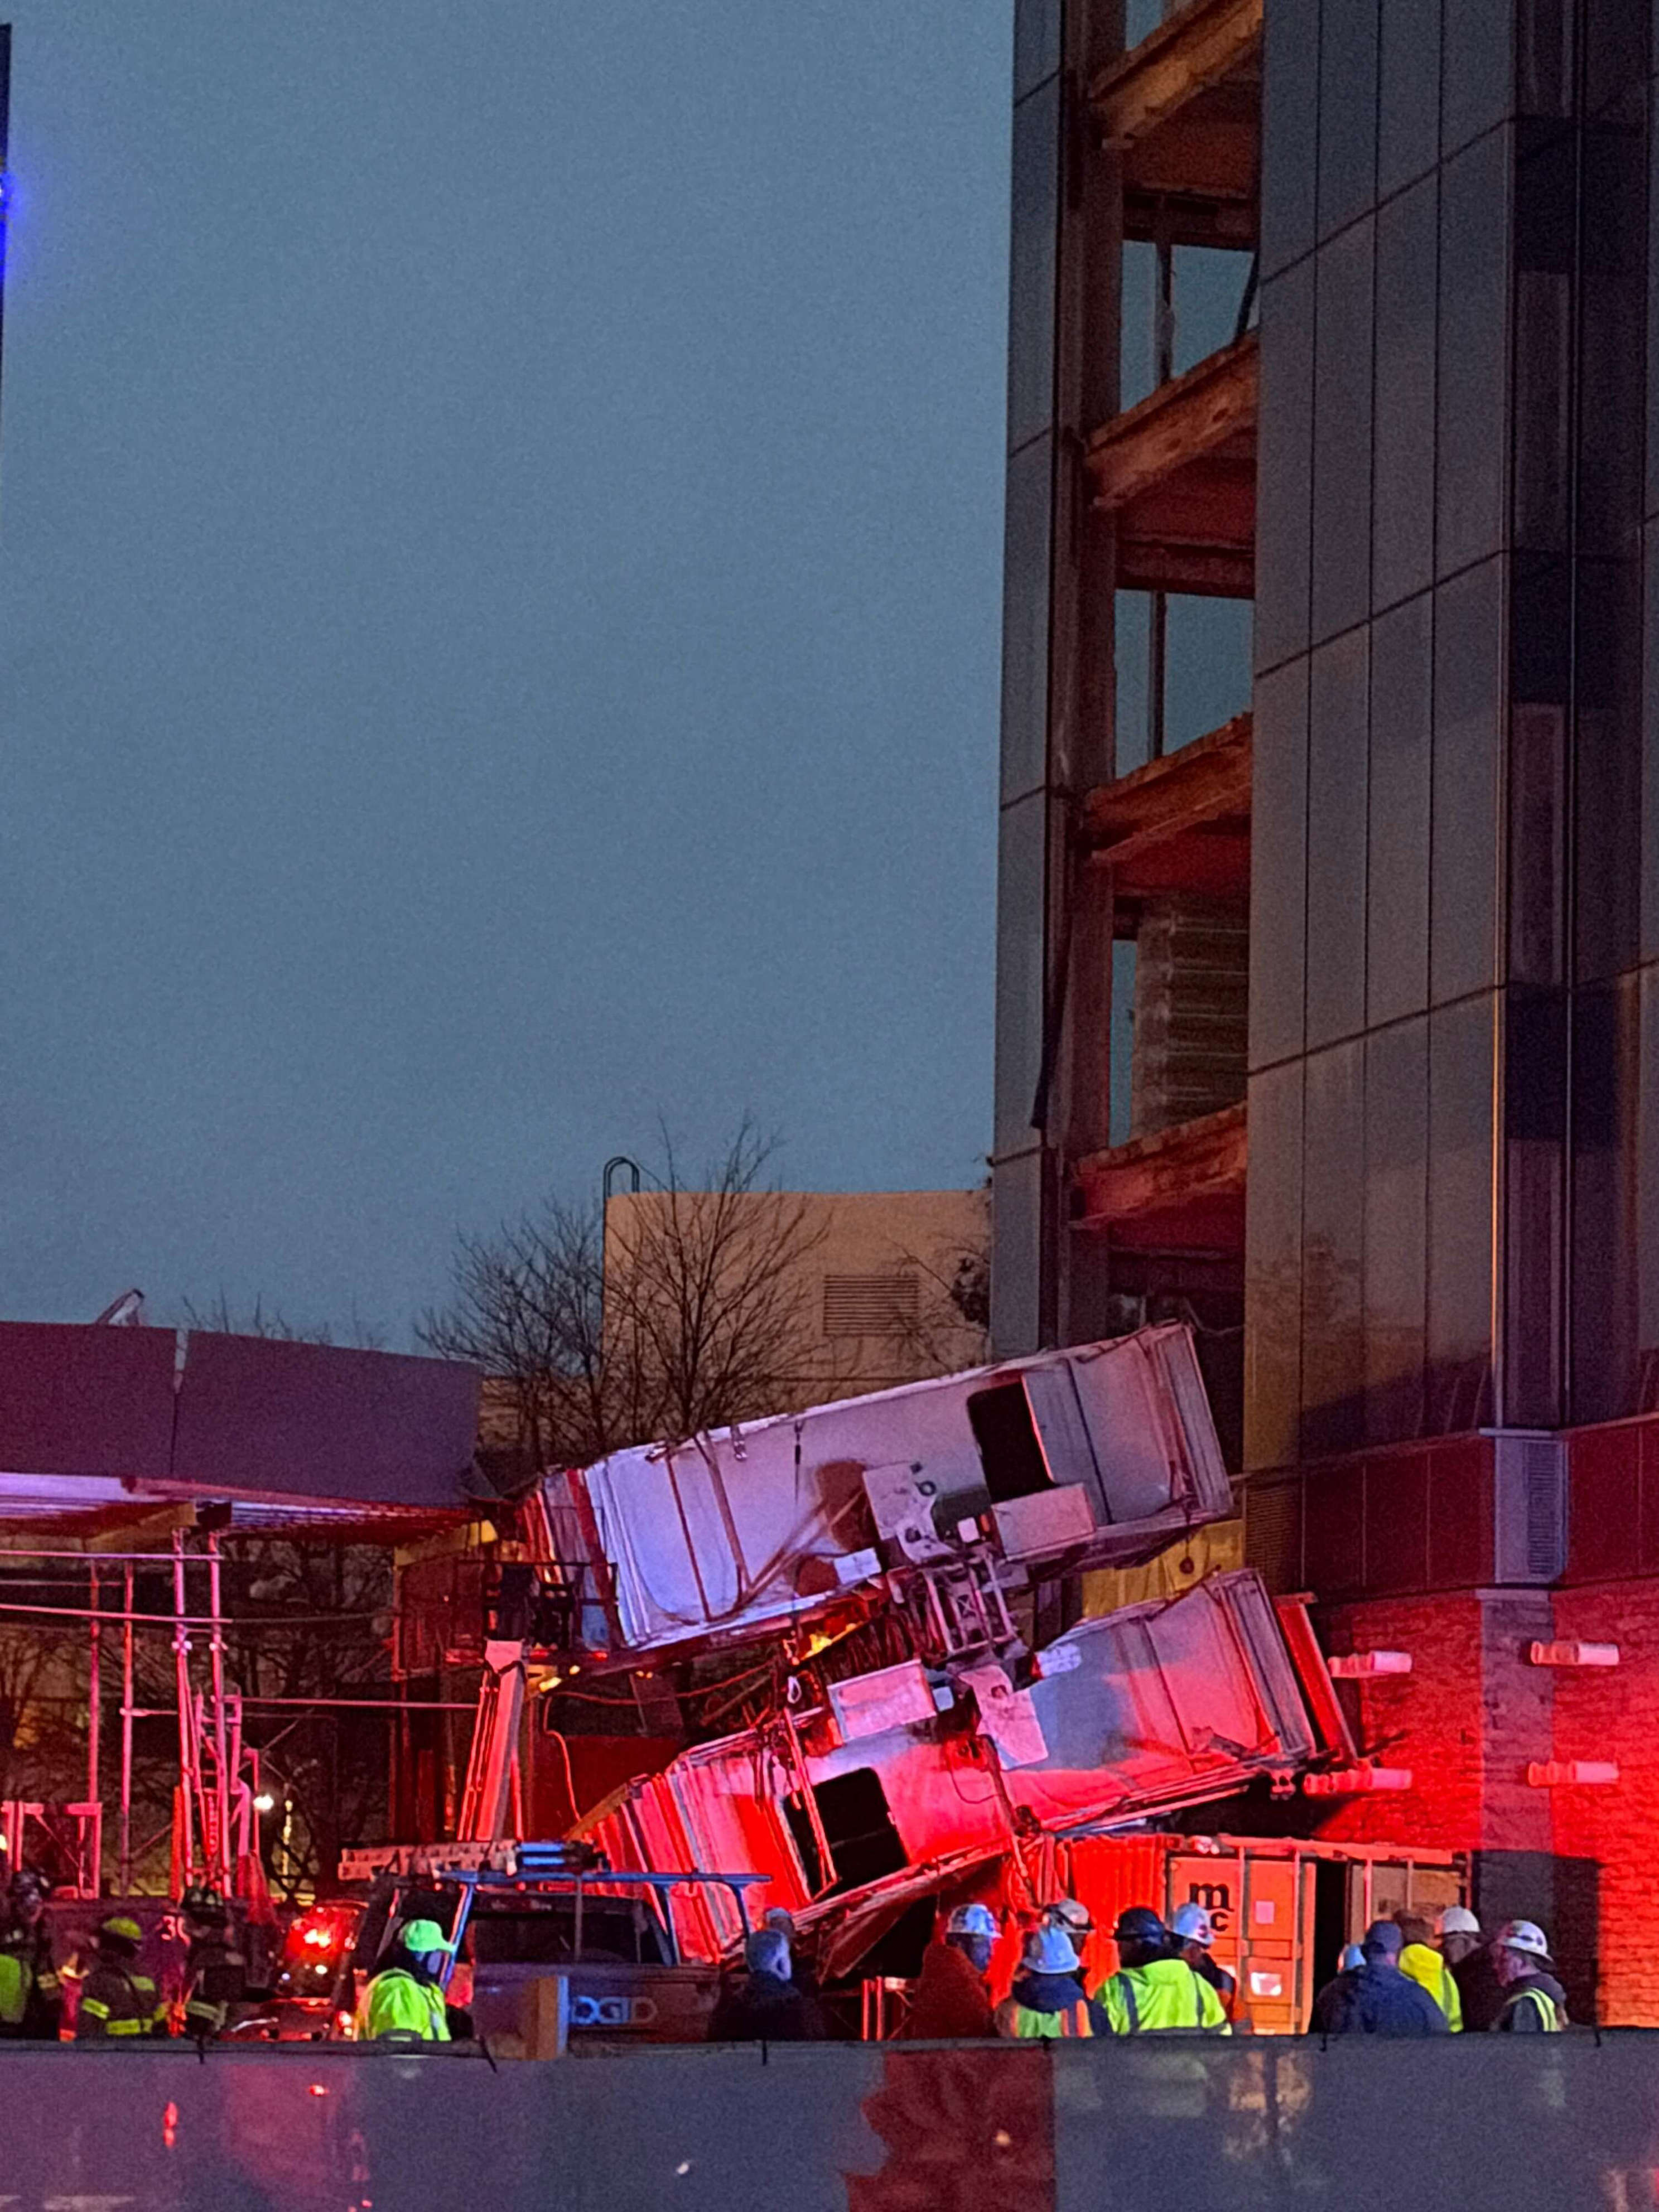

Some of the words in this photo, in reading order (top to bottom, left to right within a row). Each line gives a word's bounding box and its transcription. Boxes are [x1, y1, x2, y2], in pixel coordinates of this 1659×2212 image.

[1189, 1882, 1234, 1911] m
[1209, 1911, 1229, 1931] c
[571, 1996, 658, 2025] DGID
